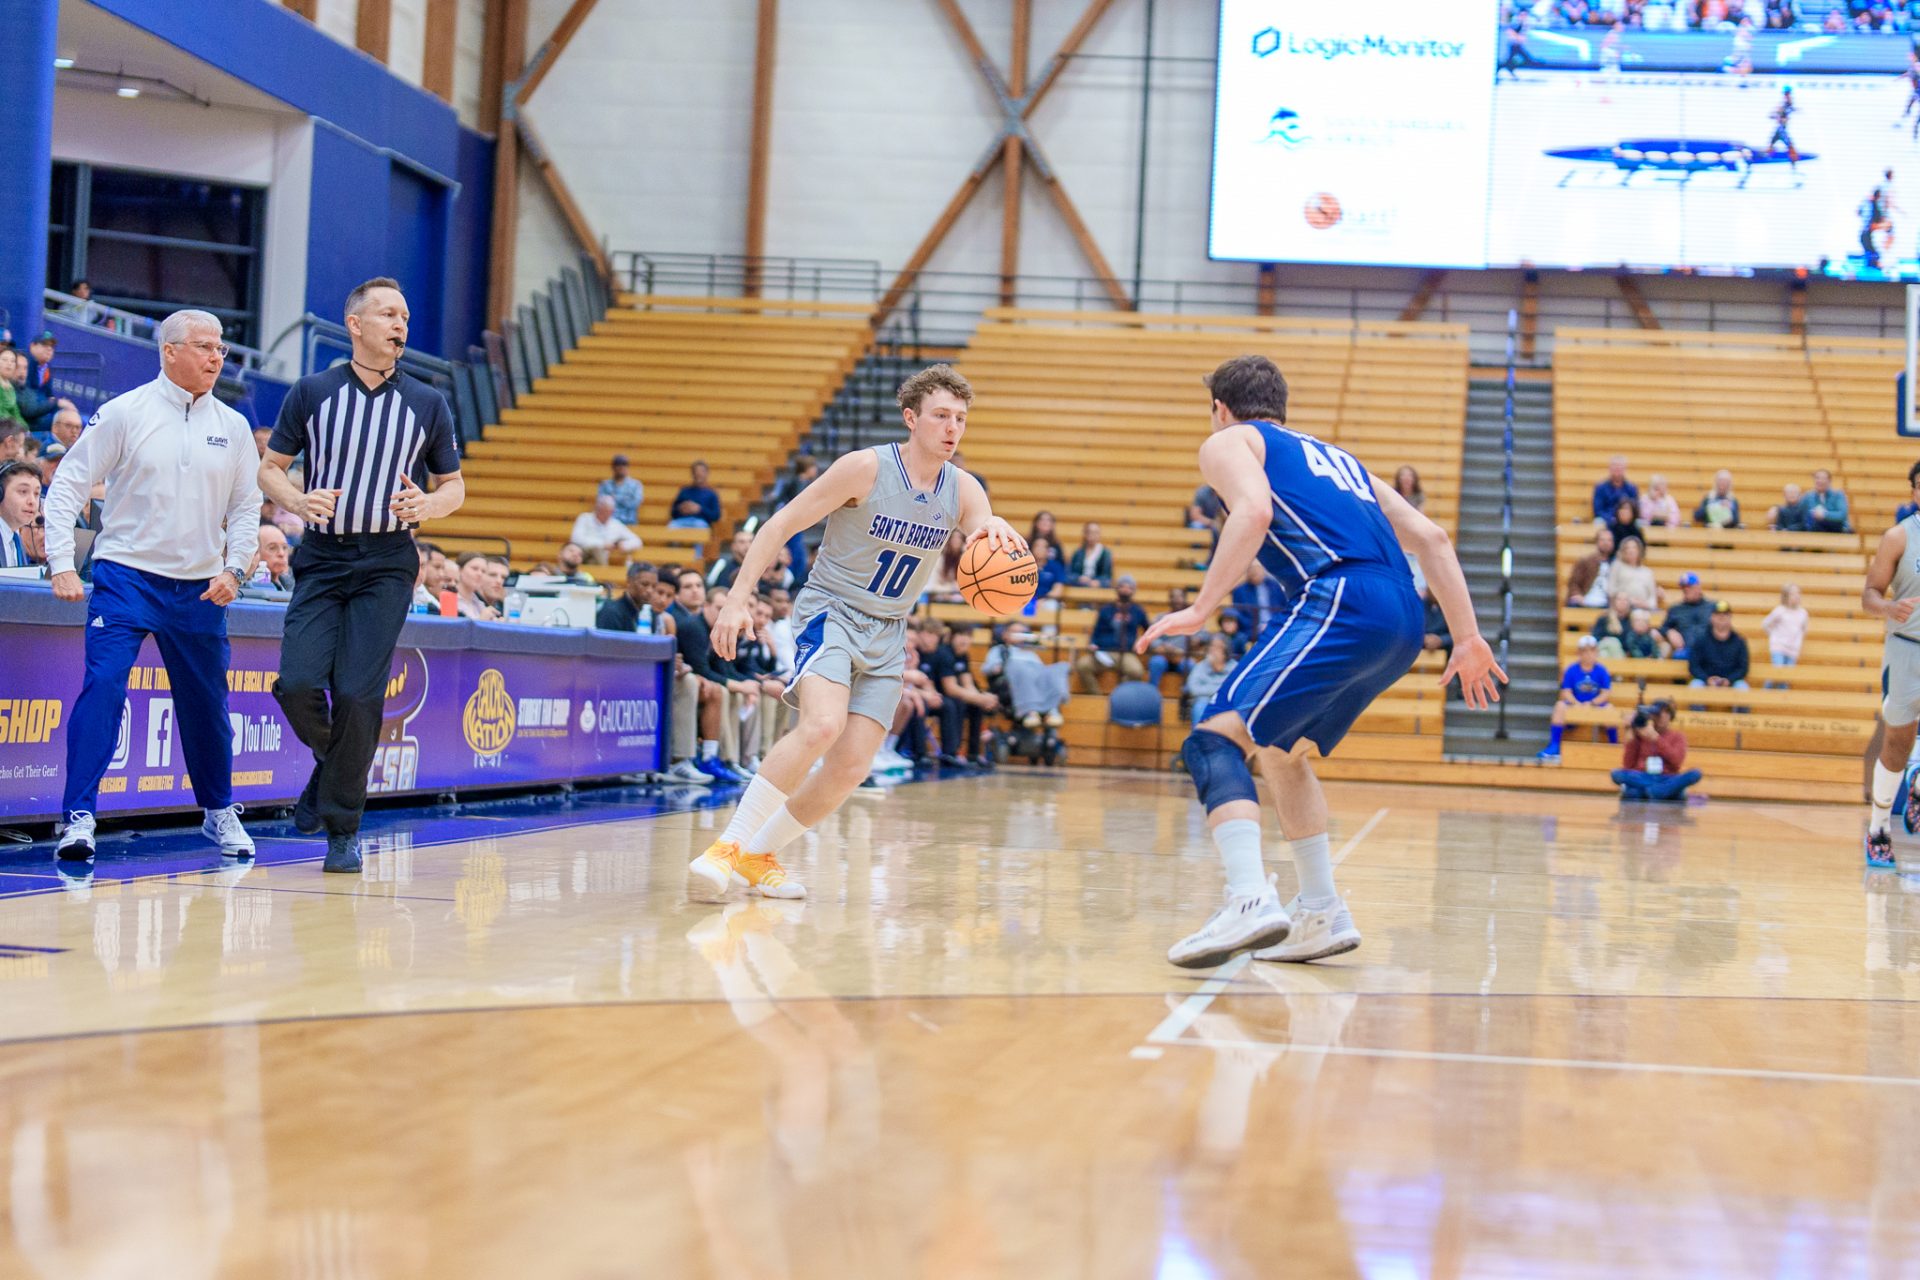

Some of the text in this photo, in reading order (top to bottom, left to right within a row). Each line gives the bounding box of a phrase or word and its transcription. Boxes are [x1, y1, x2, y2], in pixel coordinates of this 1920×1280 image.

[1289, 32, 1466, 60] LogicMonitor
[1300, 439, 1376, 503] 40
[868, 514, 909, 544] SANTA
[866, 549, 922, 599] 10
[1010, 571, 1038, 586] ilson
[0, 699, 62, 743] SHOP
[244, 715, 281, 752] YouTube
[13, 765, 25, 778] Get
[26, 764, 42, 777] Their
[42, 764, 59, 777] Gear!
[366, 745, 416, 792] CSB
